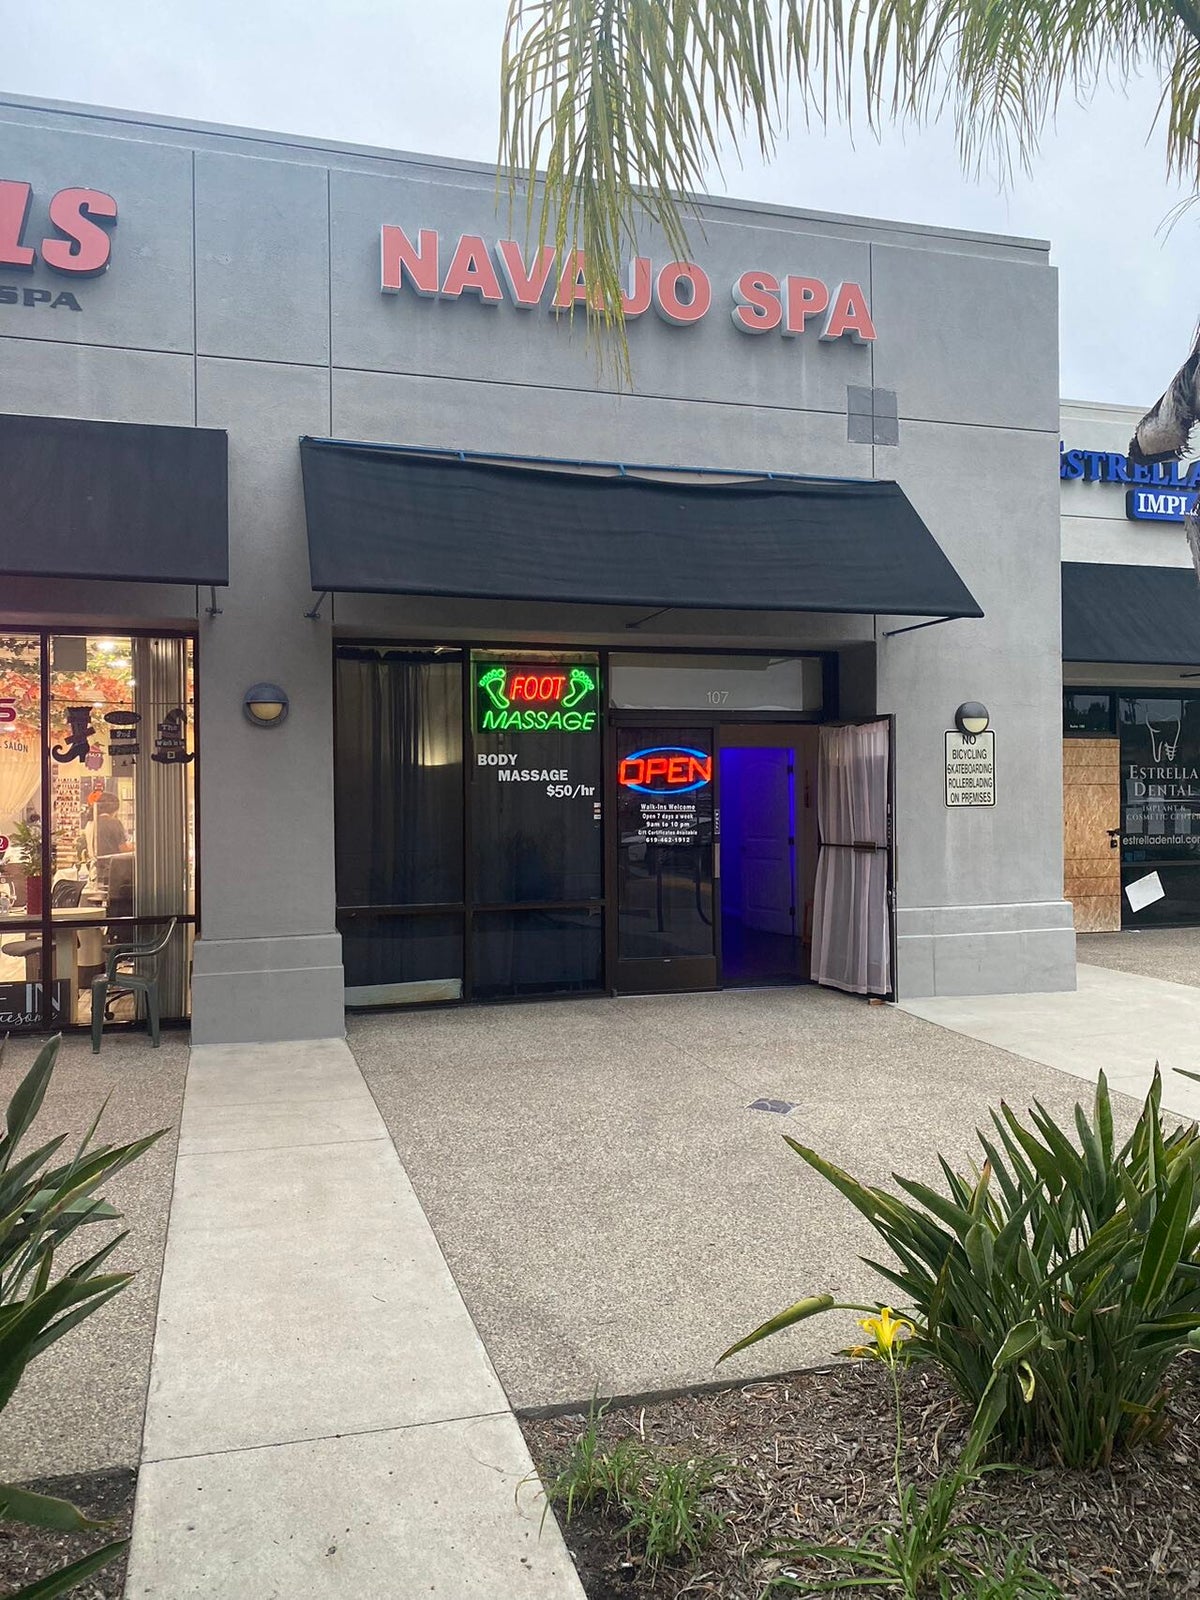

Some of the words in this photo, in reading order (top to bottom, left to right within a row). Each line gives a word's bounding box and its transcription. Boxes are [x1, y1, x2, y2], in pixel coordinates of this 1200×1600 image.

[380, 224, 712, 327] NAVAJO
[732, 270, 877, 345] SPA
[1137, 492, 1198, 517] IMPL
[510, 676, 566, 700] FOOT
[707, 691, 729, 704] 107
[482, 710, 597, 731] MASSAGE
[4, 740, 29, 753] SALON
[962, 735, 976, 745] NO
[477, 754, 518, 766] BODY
[952, 748, 987, 760] BICYCLING
[498, 769, 569, 782] MASSAGE
[619, 756, 713, 785] OPEN
[947, 763, 993, 775] SKATEBOARDING
[1129, 764, 1199, 780] ESTRELLA
[948, 777, 993, 789] ROLLERBLADING
[1134, 781, 1194, 797] DENTAL
[546, 784, 596, 799] $50/hr
[950, 792, 960, 804] ON
[961, 791, 992, 804] PREMISES
[1142, 804, 1178, 812] IMPLANT
[656, 812, 661, 820] 7
[661, 812, 674, 821] days
[679, 812, 694, 820] week
[1122, 835, 1200, 846] estrelladental.co
